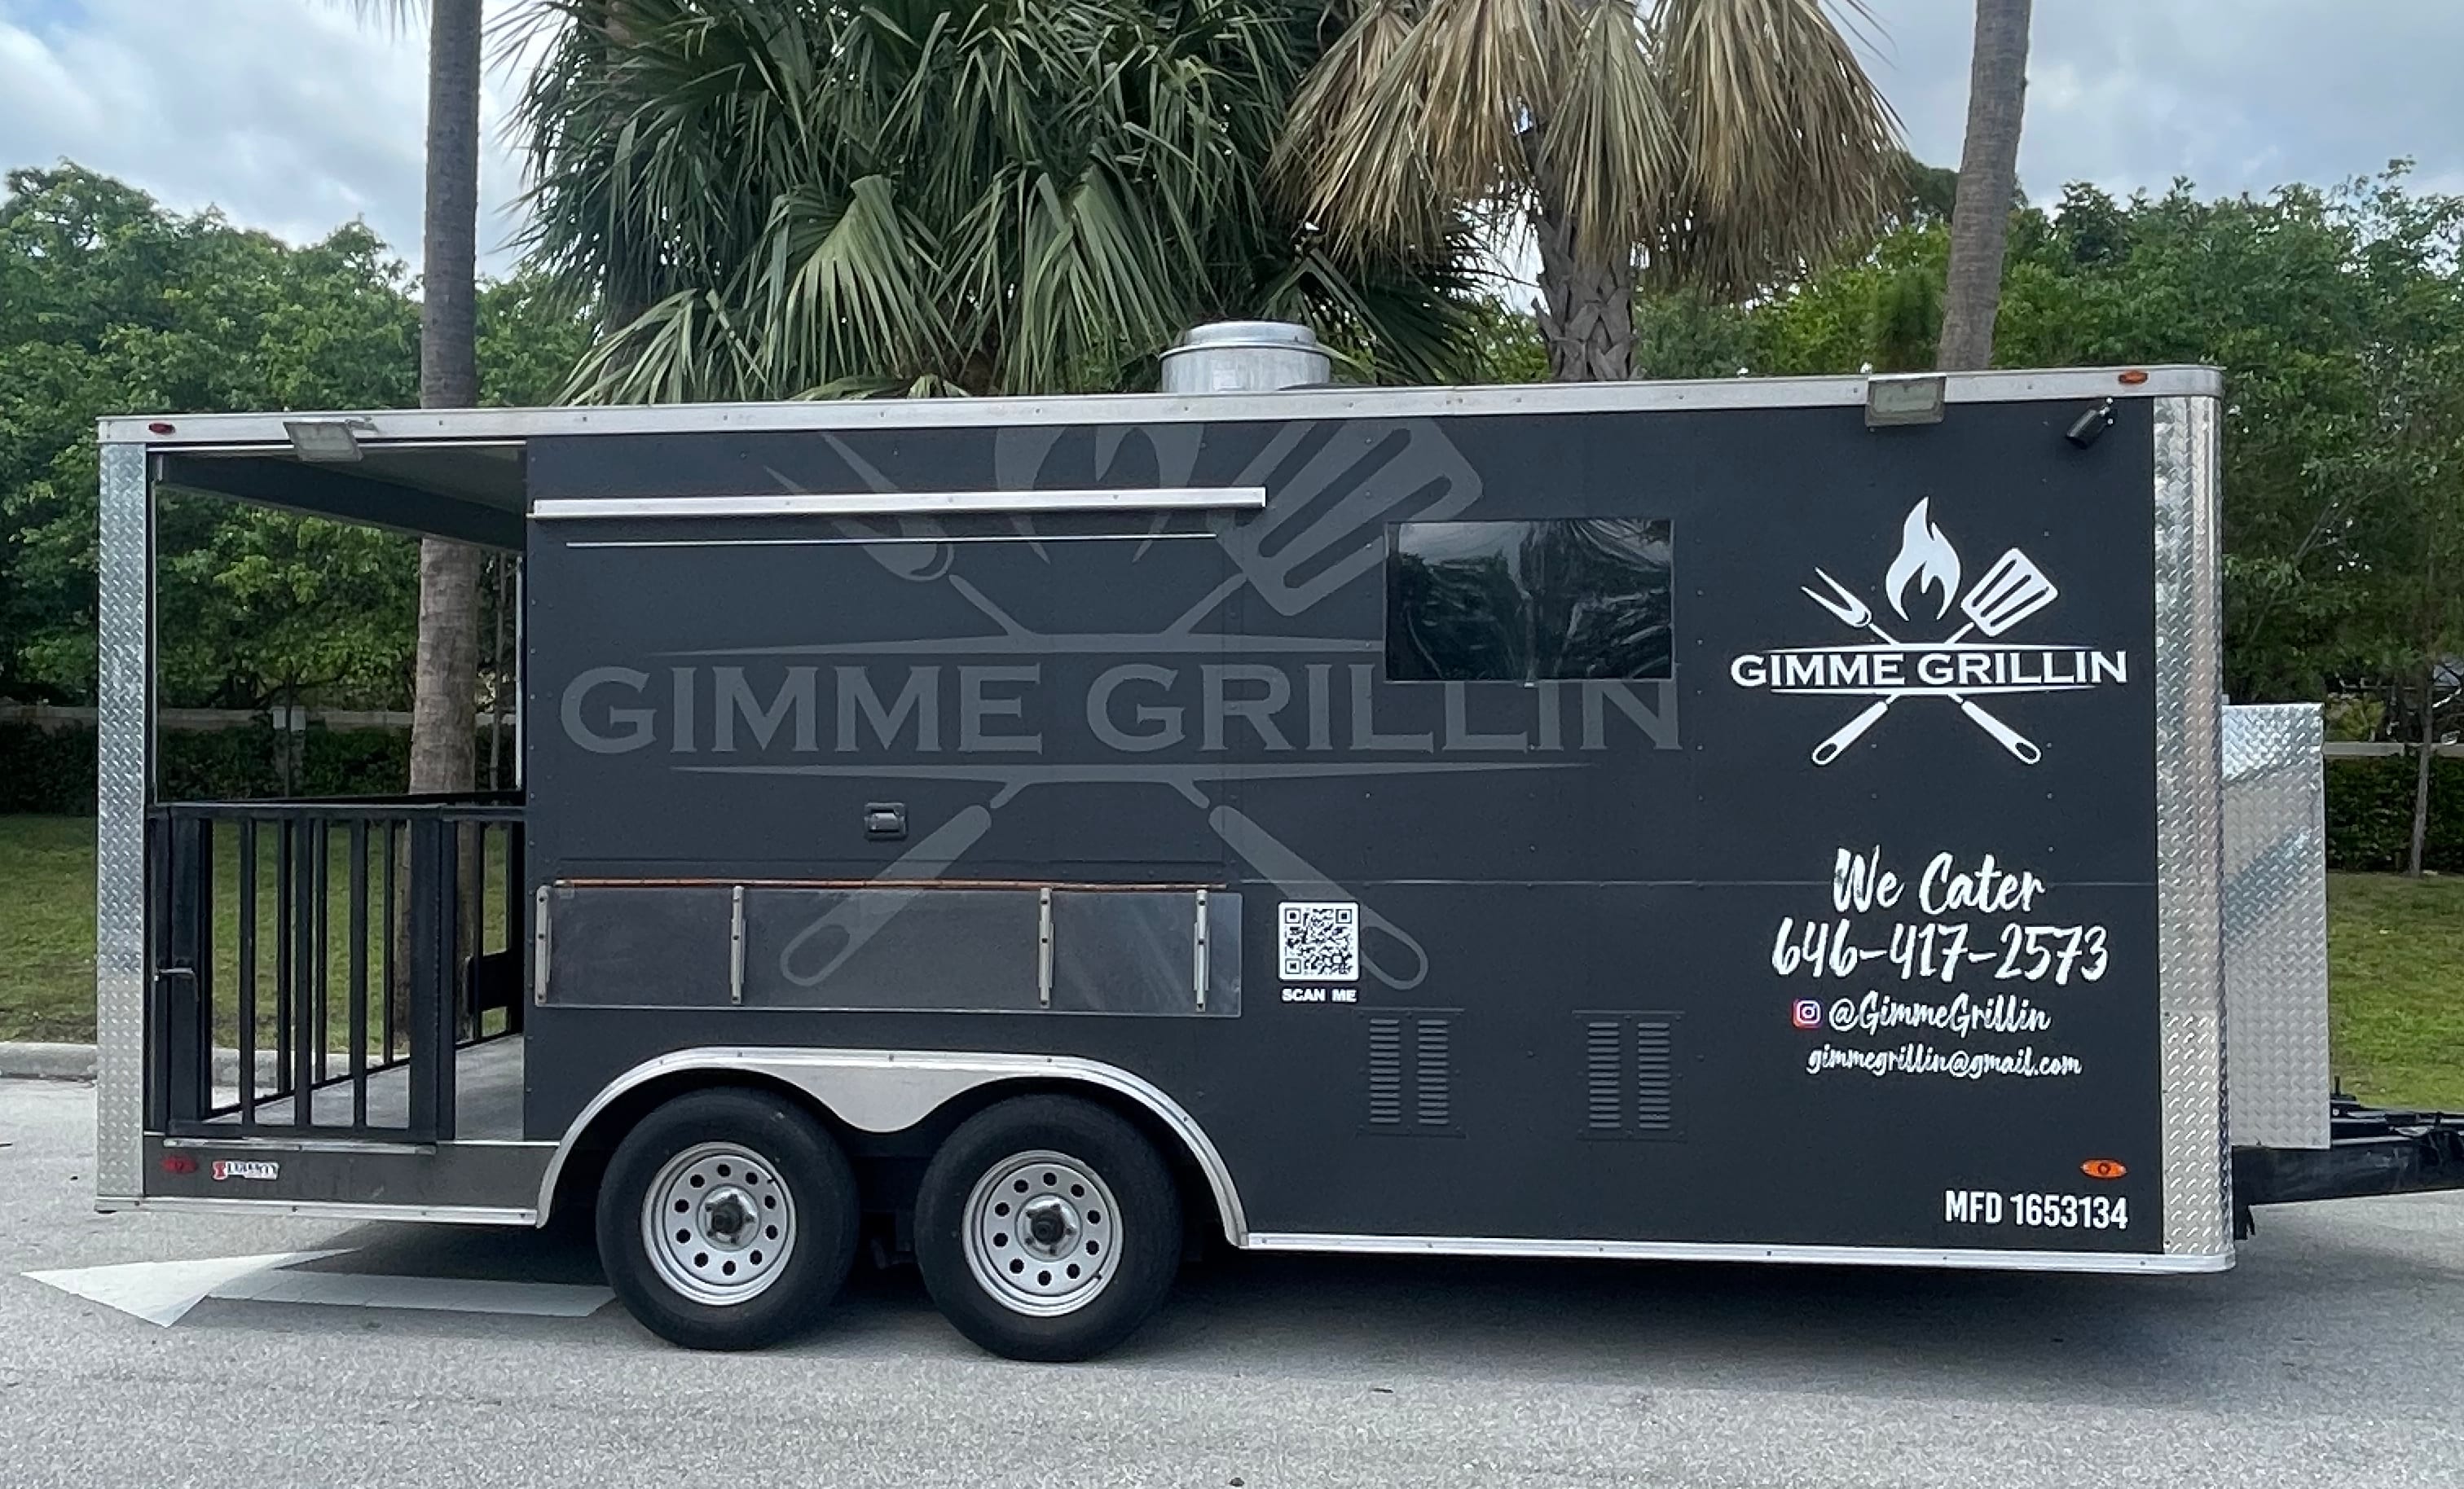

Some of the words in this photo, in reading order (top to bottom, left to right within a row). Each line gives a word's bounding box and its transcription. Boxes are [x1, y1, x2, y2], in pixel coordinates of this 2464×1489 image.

[1731, 652, 1905, 687] GIMME
[1917, 651, 2127, 685] GRILLIN
[561, 662, 1043, 754] GIMME
[1086, 661, 1683, 753] GRILLIN
[1833, 845, 1905, 913] We
[1918, 851, 2045, 915] Cater
[1771, 916, 2109, 985] 646-417-2573
[1281, 987, 1327, 1003] SCAN
[1331, 988, 1358, 1003] ME
[1828, 990, 2052, 1039] @GimmeGrillin
[1806, 1043, 2083, 1079] gimmegrillin@gmail.com
[1945, 1190, 2003, 1223] MFD
[2009, 1193, 2128, 1229] 1653134
